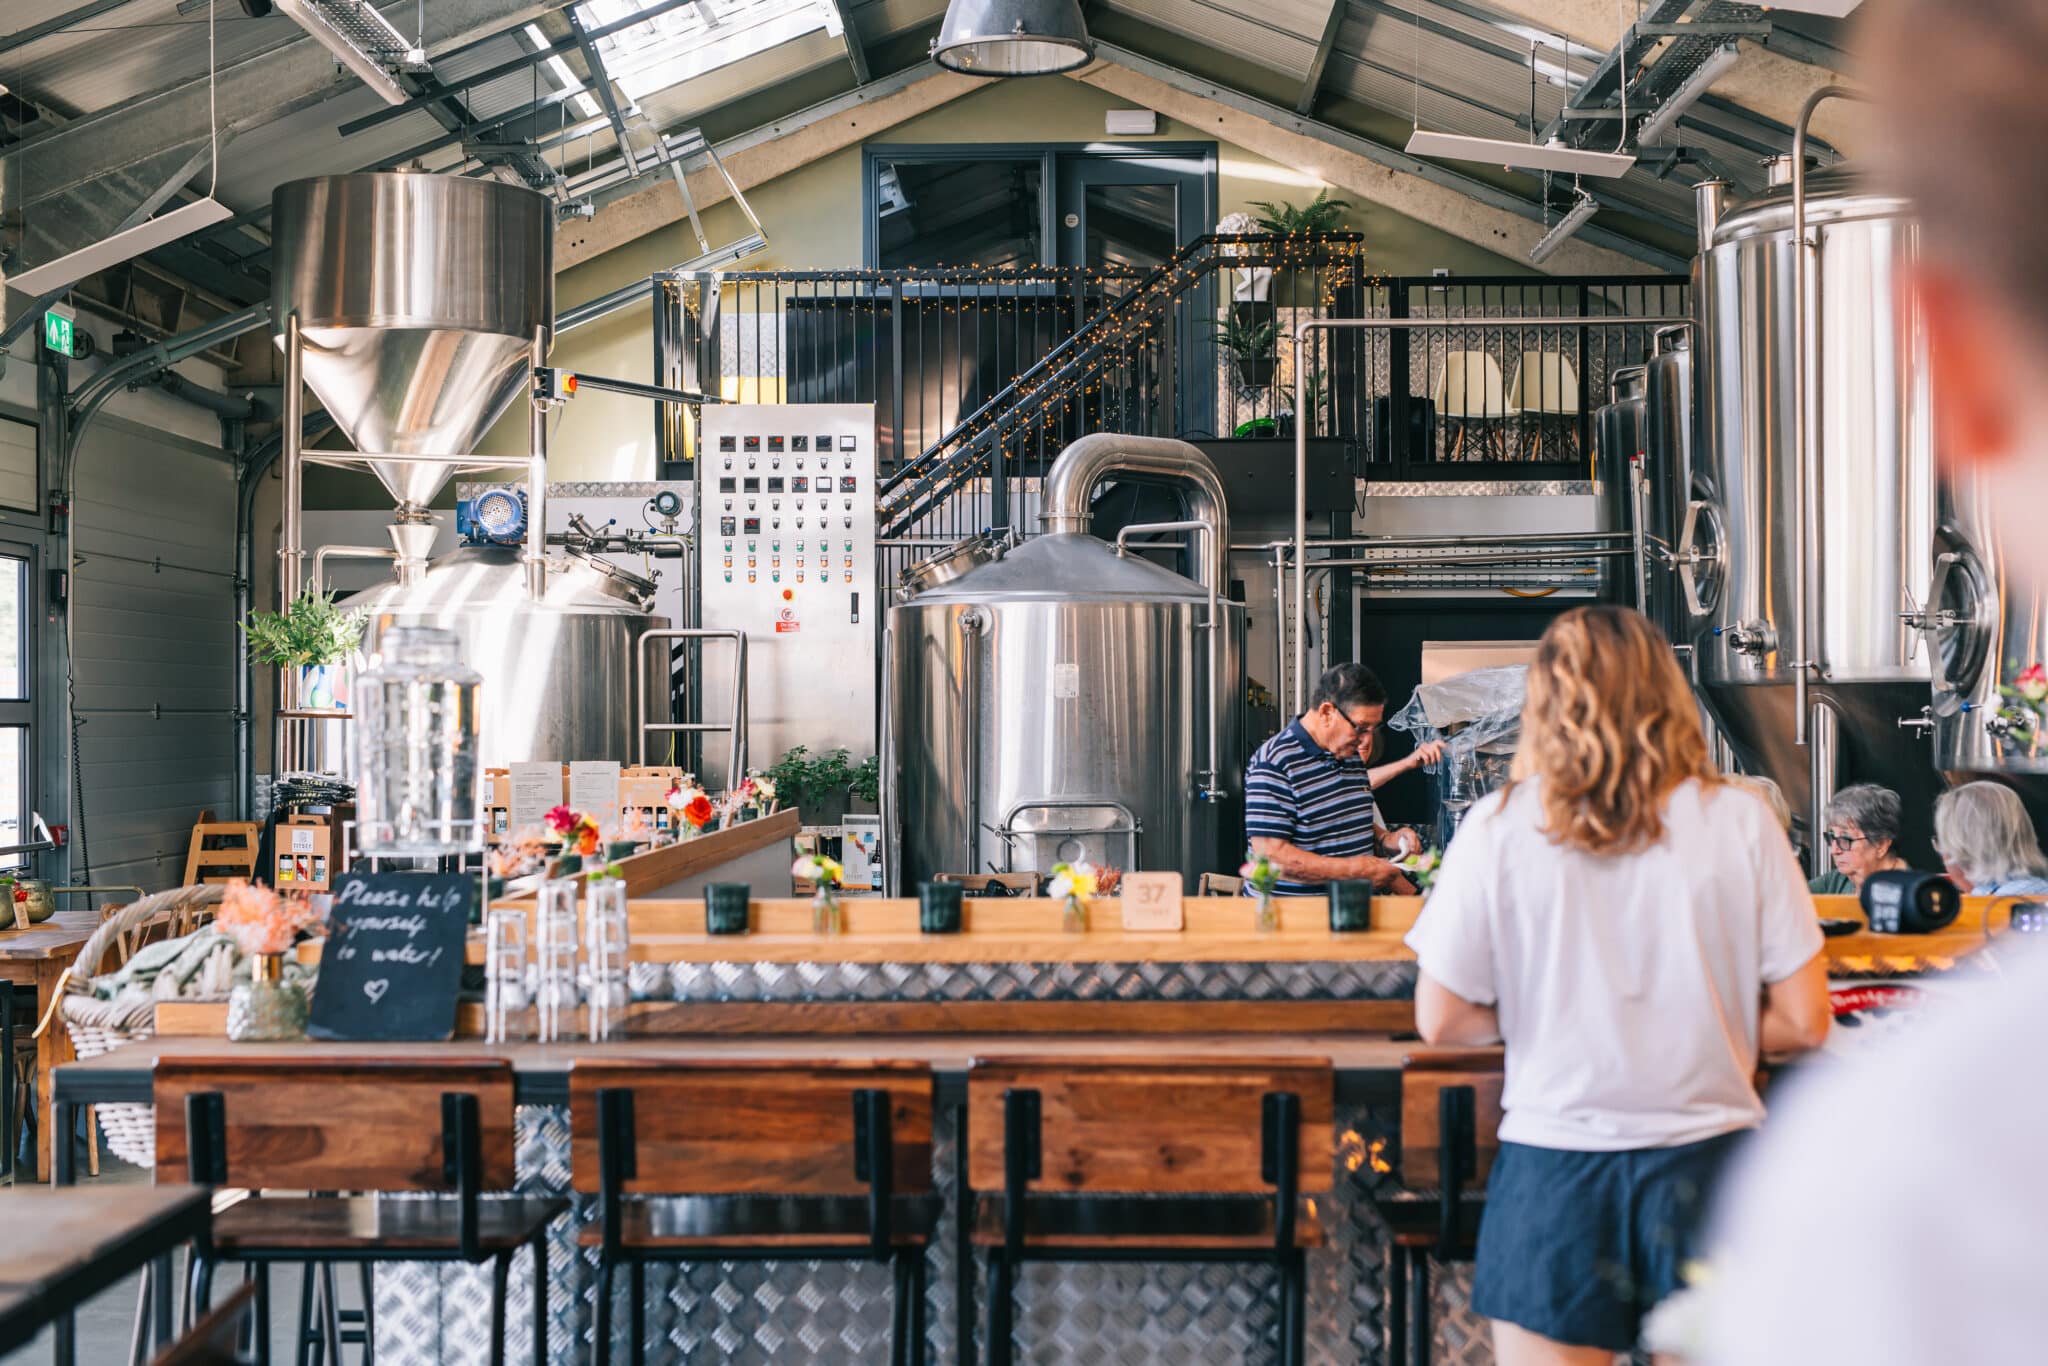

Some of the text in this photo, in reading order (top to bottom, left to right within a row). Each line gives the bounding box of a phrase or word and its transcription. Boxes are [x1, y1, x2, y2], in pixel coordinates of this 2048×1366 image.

[339, 879, 462, 913] Please help
[1137, 883, 1166, 904] 37
[346, 914, 427, 939] yourself
[337, 945, 357, 960] to
